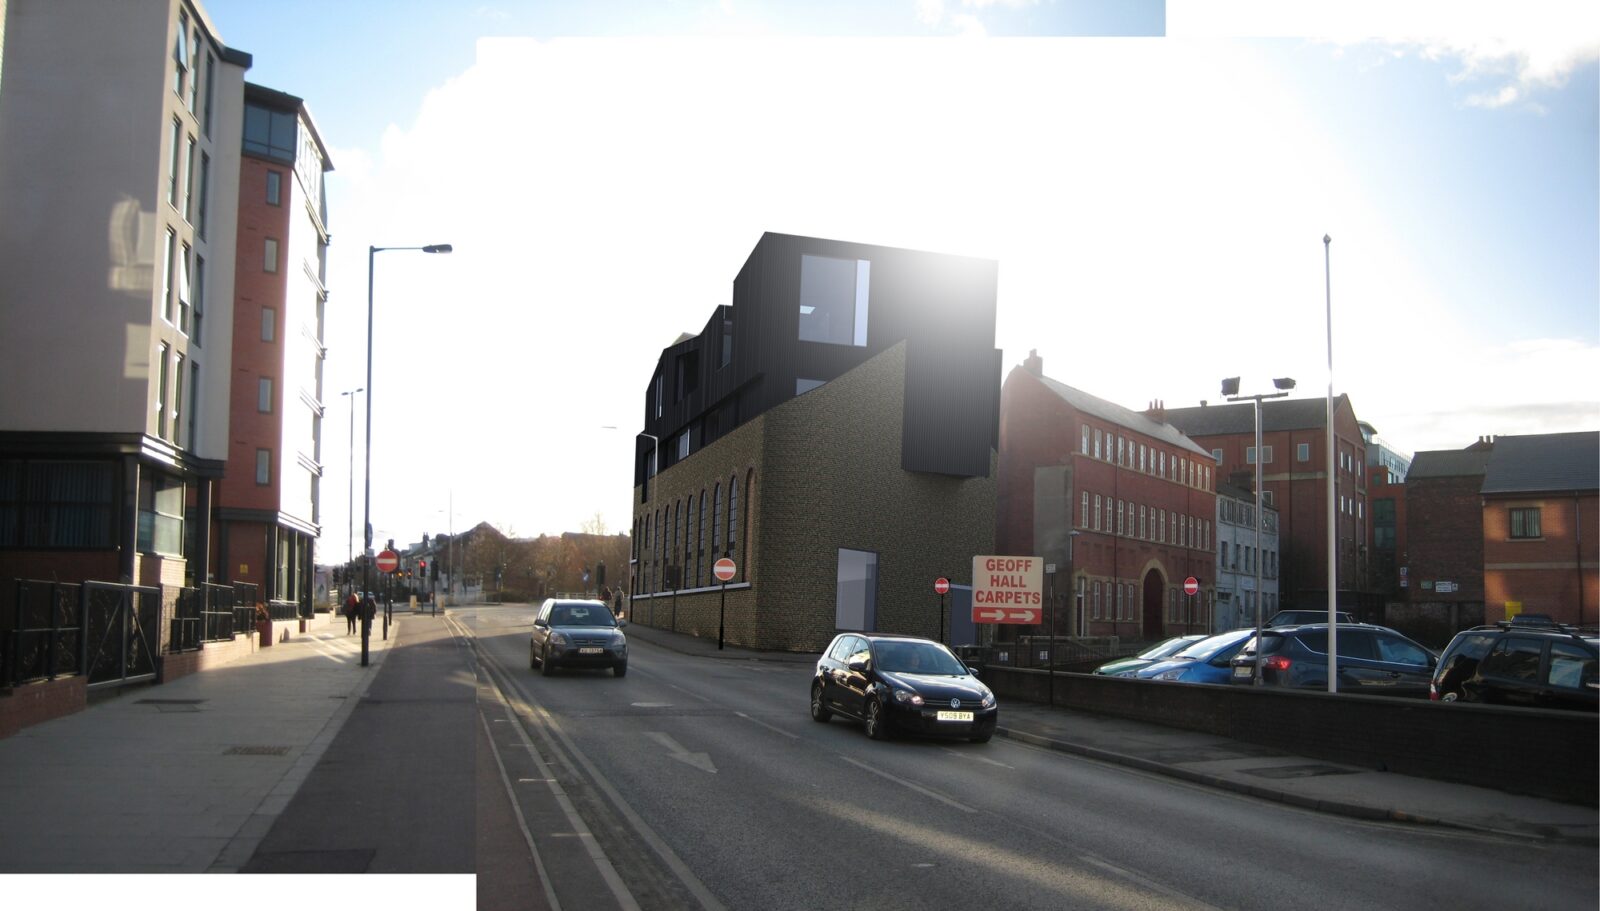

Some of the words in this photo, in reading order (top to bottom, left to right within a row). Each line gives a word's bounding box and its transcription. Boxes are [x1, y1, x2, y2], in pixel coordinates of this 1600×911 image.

[986, 558, 1032, 572] GEOFF
[990, 575, 1027, 588] HALL
[975, 590, 1041, 604] CARPETS
[958, 712, 971, 720] BYA
